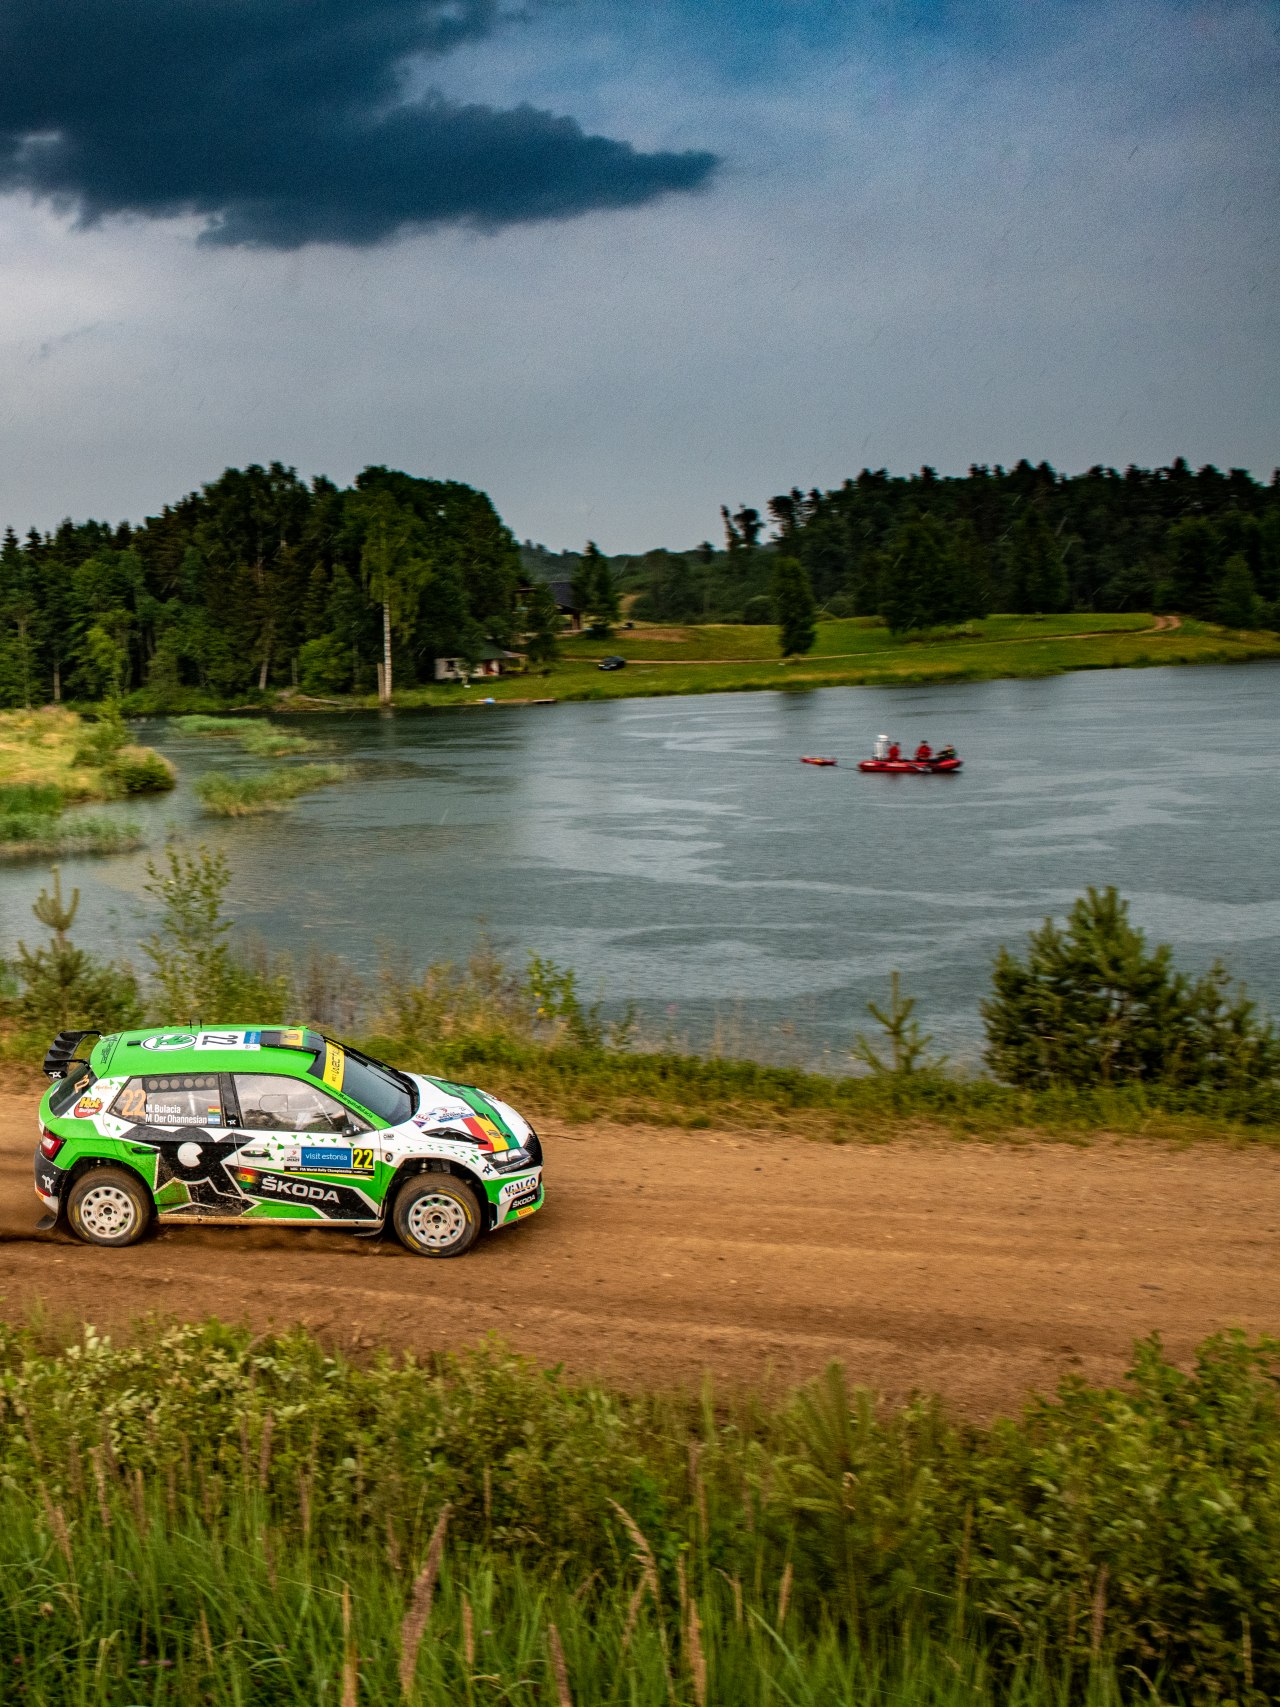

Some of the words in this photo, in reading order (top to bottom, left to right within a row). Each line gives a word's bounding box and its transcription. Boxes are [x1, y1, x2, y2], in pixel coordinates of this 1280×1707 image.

[202, 1035, 238, 1046] 22
[79, 1097, 101, 1109] Hot
[122, 1089, 147, 1116] 22
[155, 1104, 181, 1114] Bulacia
[154, 1114, 167, 1123] Der
[167, 1115, 207, 1125] Ohannesian
[305, 1152, 321, 1160] visit
[321, 1153, 348, 1161] estonia
[353, 1149, 373, 1168] 22
[261, 1175, 340, 1204] ŠKODA
